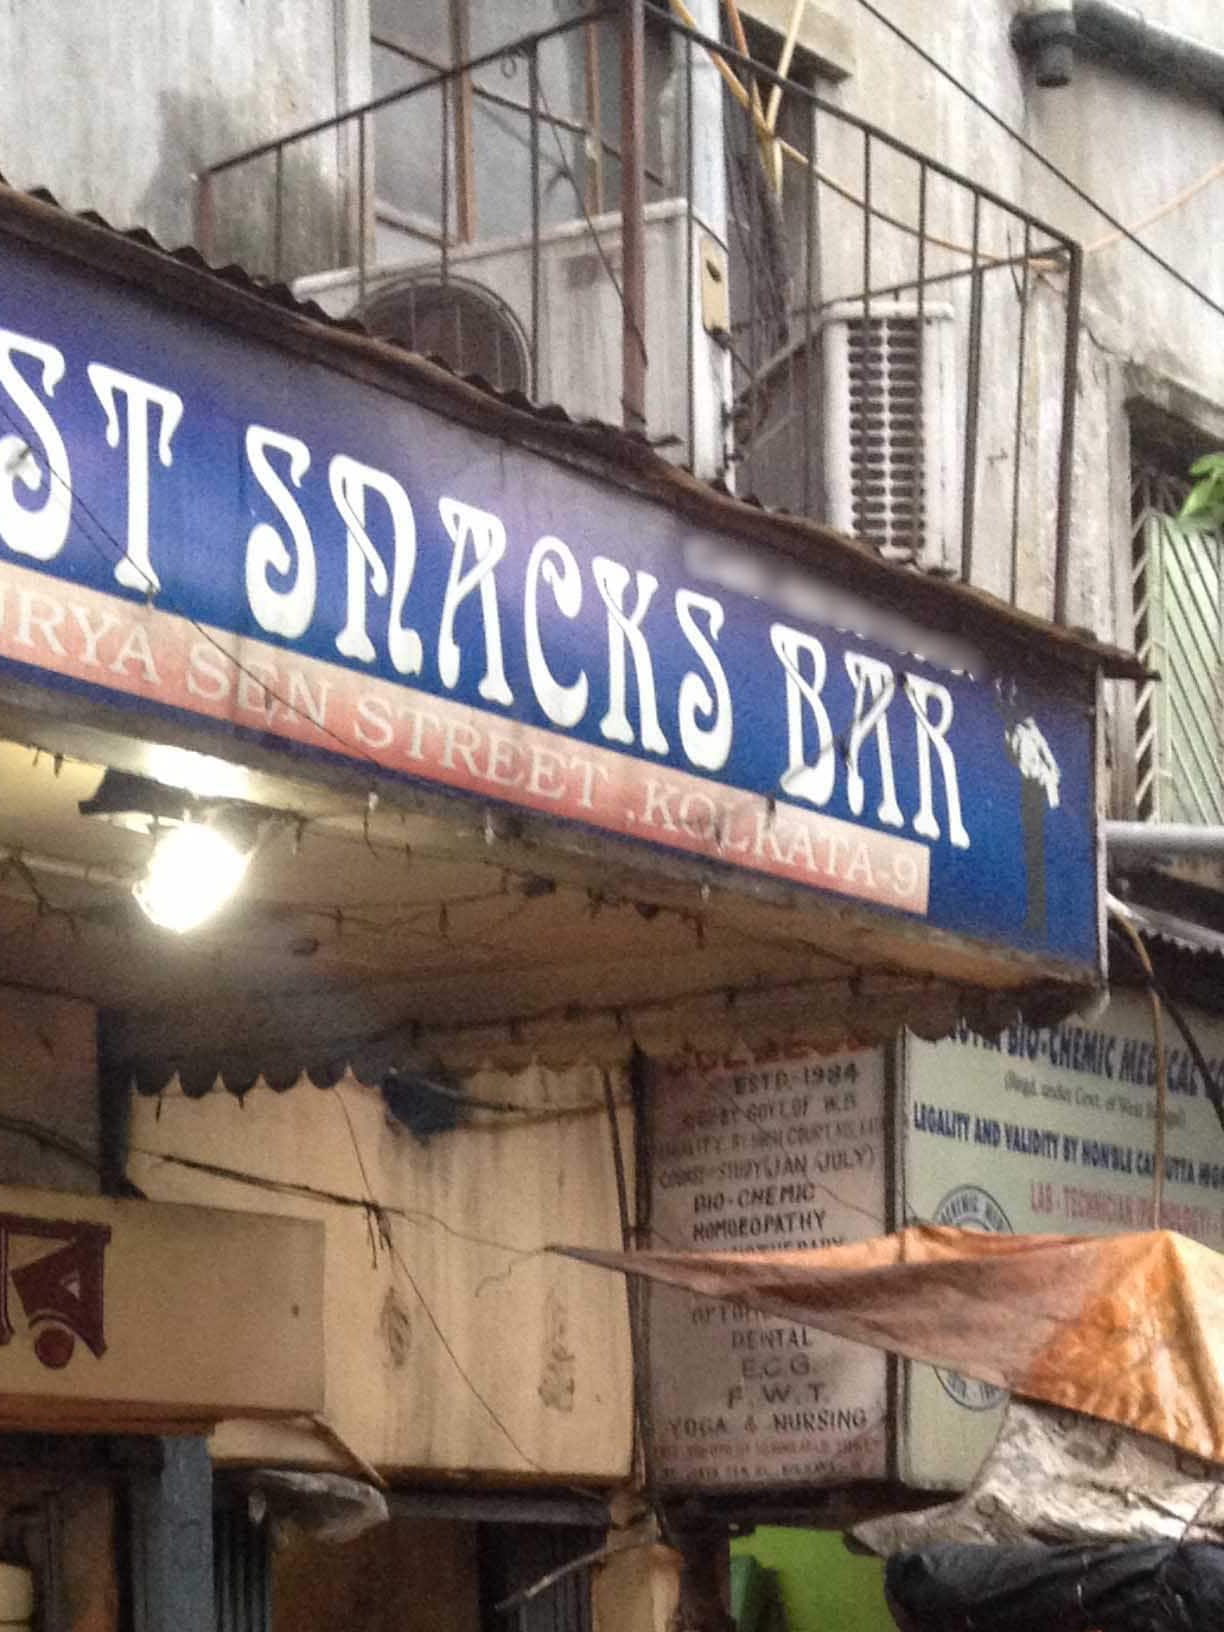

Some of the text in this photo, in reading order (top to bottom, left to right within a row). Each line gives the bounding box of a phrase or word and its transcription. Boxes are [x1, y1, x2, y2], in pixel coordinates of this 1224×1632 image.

[245, 423, 734, 772] SNACKS
[769, 621, 971, 849] BAR
[187, 640, 335, 728] SEN
[352, 694, 609, 808] STREET
[913, 1101, 971, 1142] LEGALITY
[973, 1110, 1001, 1148] AND
[1002, 1119, 1060, 1160] VALIDITY
[732, 1327, 812, 1353] DENTAL
[772, 1407, 868, 1436] NURSING
